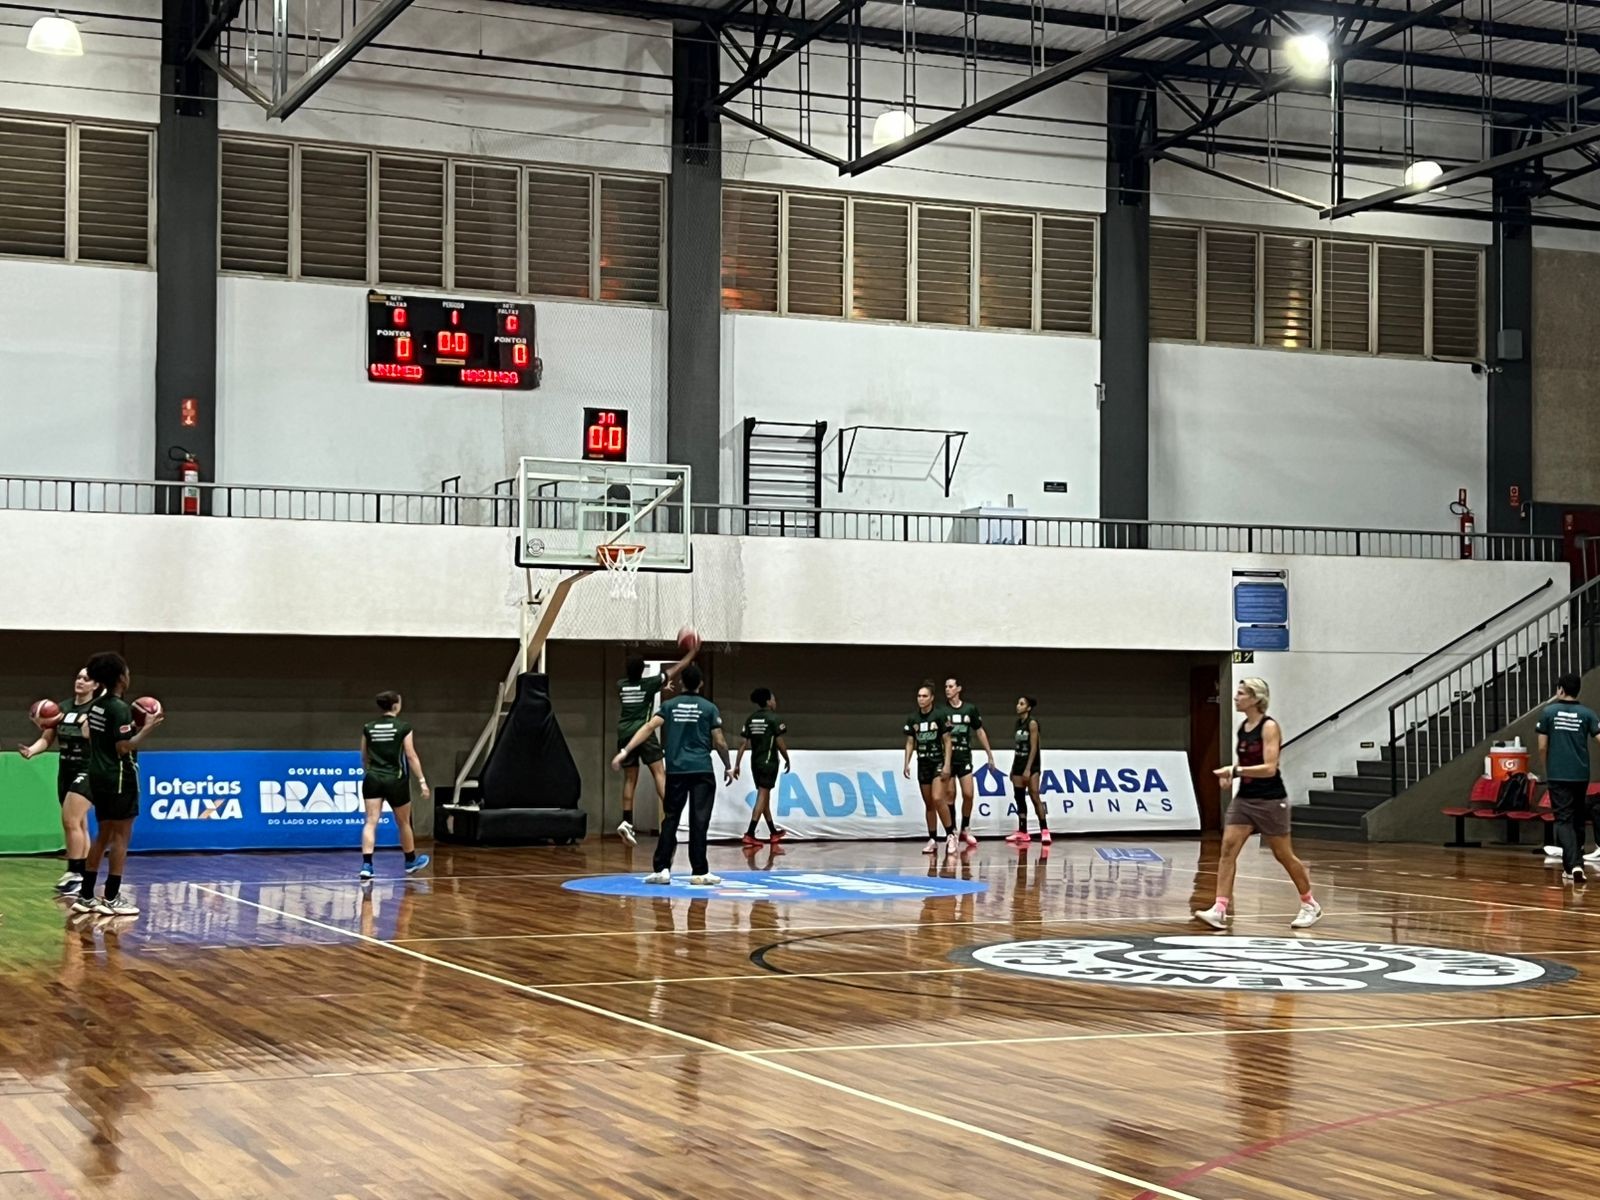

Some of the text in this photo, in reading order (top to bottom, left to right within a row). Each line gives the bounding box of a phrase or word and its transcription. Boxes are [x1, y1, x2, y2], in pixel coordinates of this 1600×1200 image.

[376, 329, 411, 337] PONTOS
[494, 336, 527, 344] PONTOS
[397, 337, 410, 357] 0
[514, 344, 527, 364] 0
[288, 767, 364, 775] GOVERNO DO
[1035, 768, 1169, 794] ANASA
[149, 774, 242, 795] loterias
[777, 771, 903, 817] ADN
[150, 798, 243, 820] CAIXA
[979, 798, 1173, 817] CAPINAS
